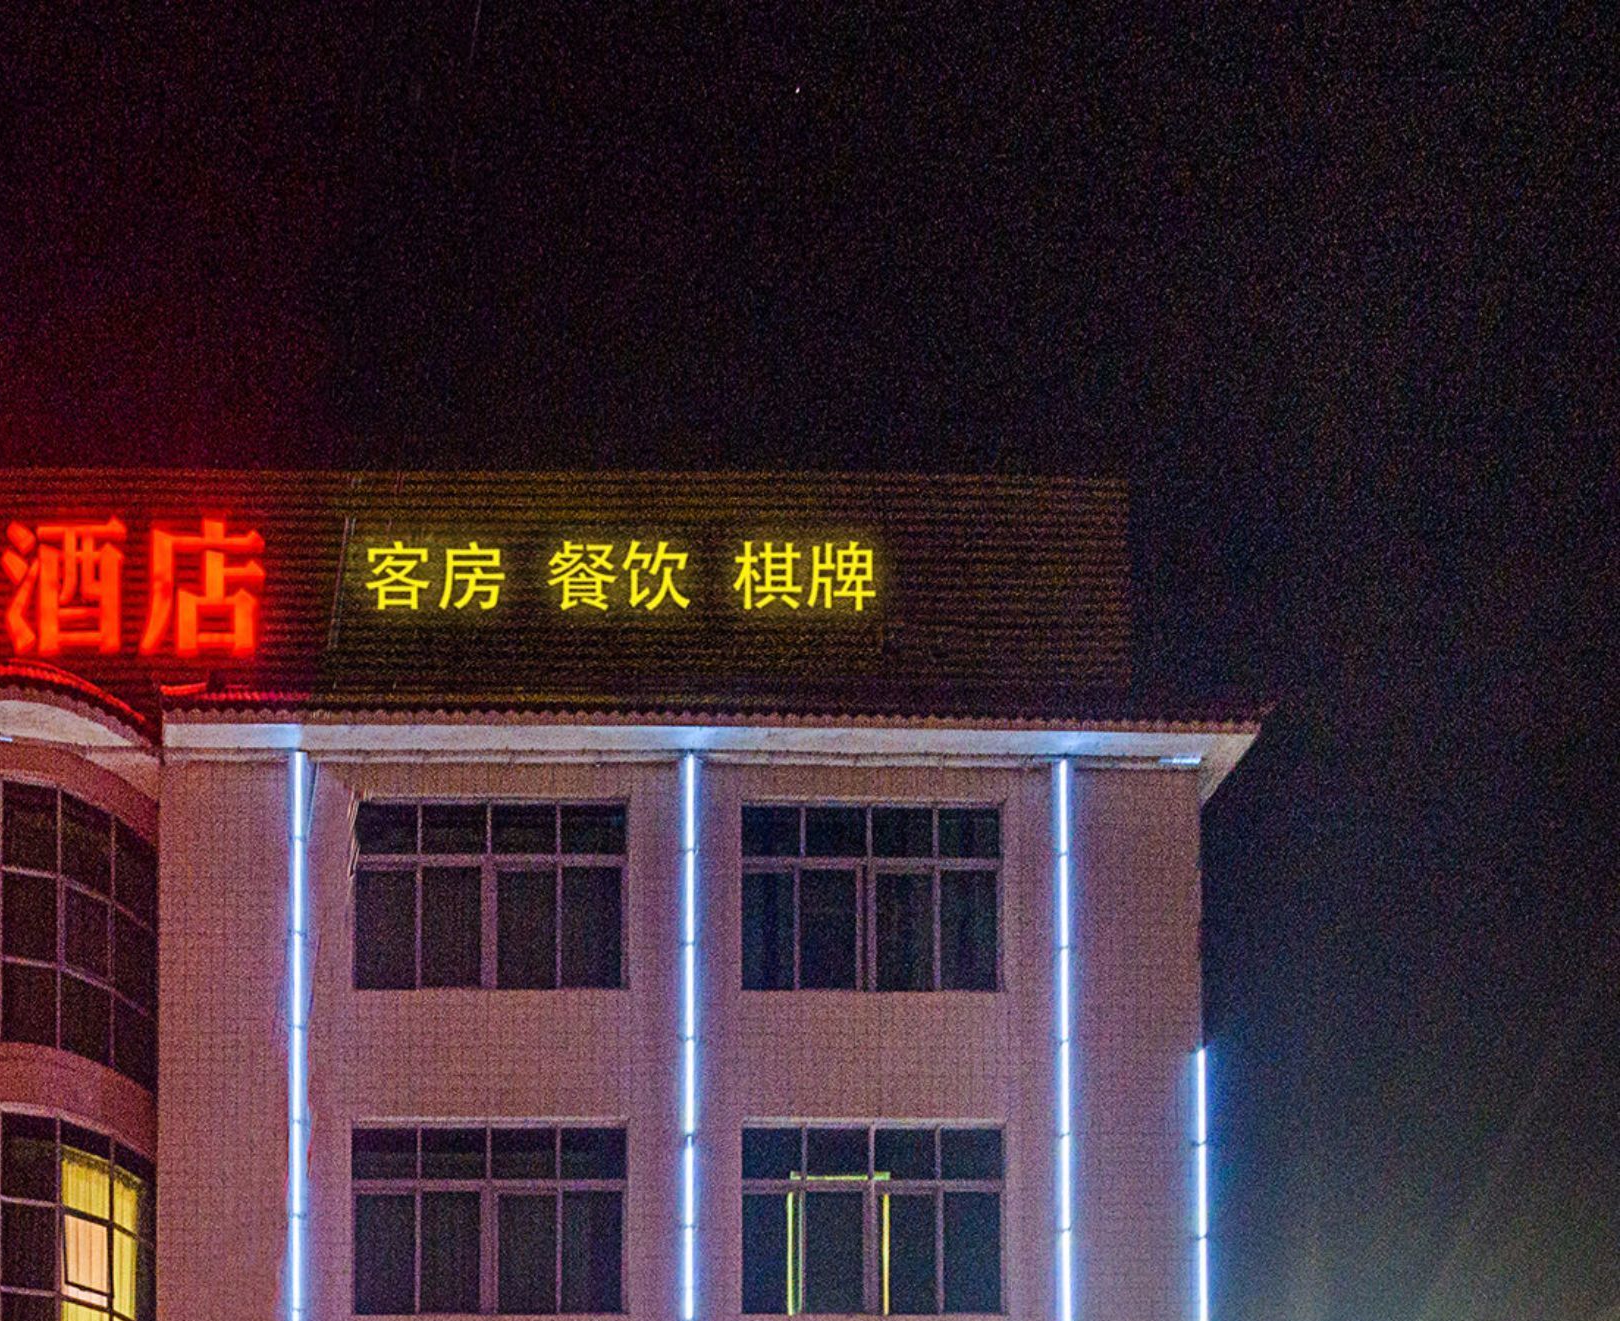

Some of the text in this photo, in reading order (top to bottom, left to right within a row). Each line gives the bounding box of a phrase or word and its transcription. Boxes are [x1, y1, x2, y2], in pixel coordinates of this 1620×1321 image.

[365, 540, 876, 612] 客房 餐饮 棋牌
